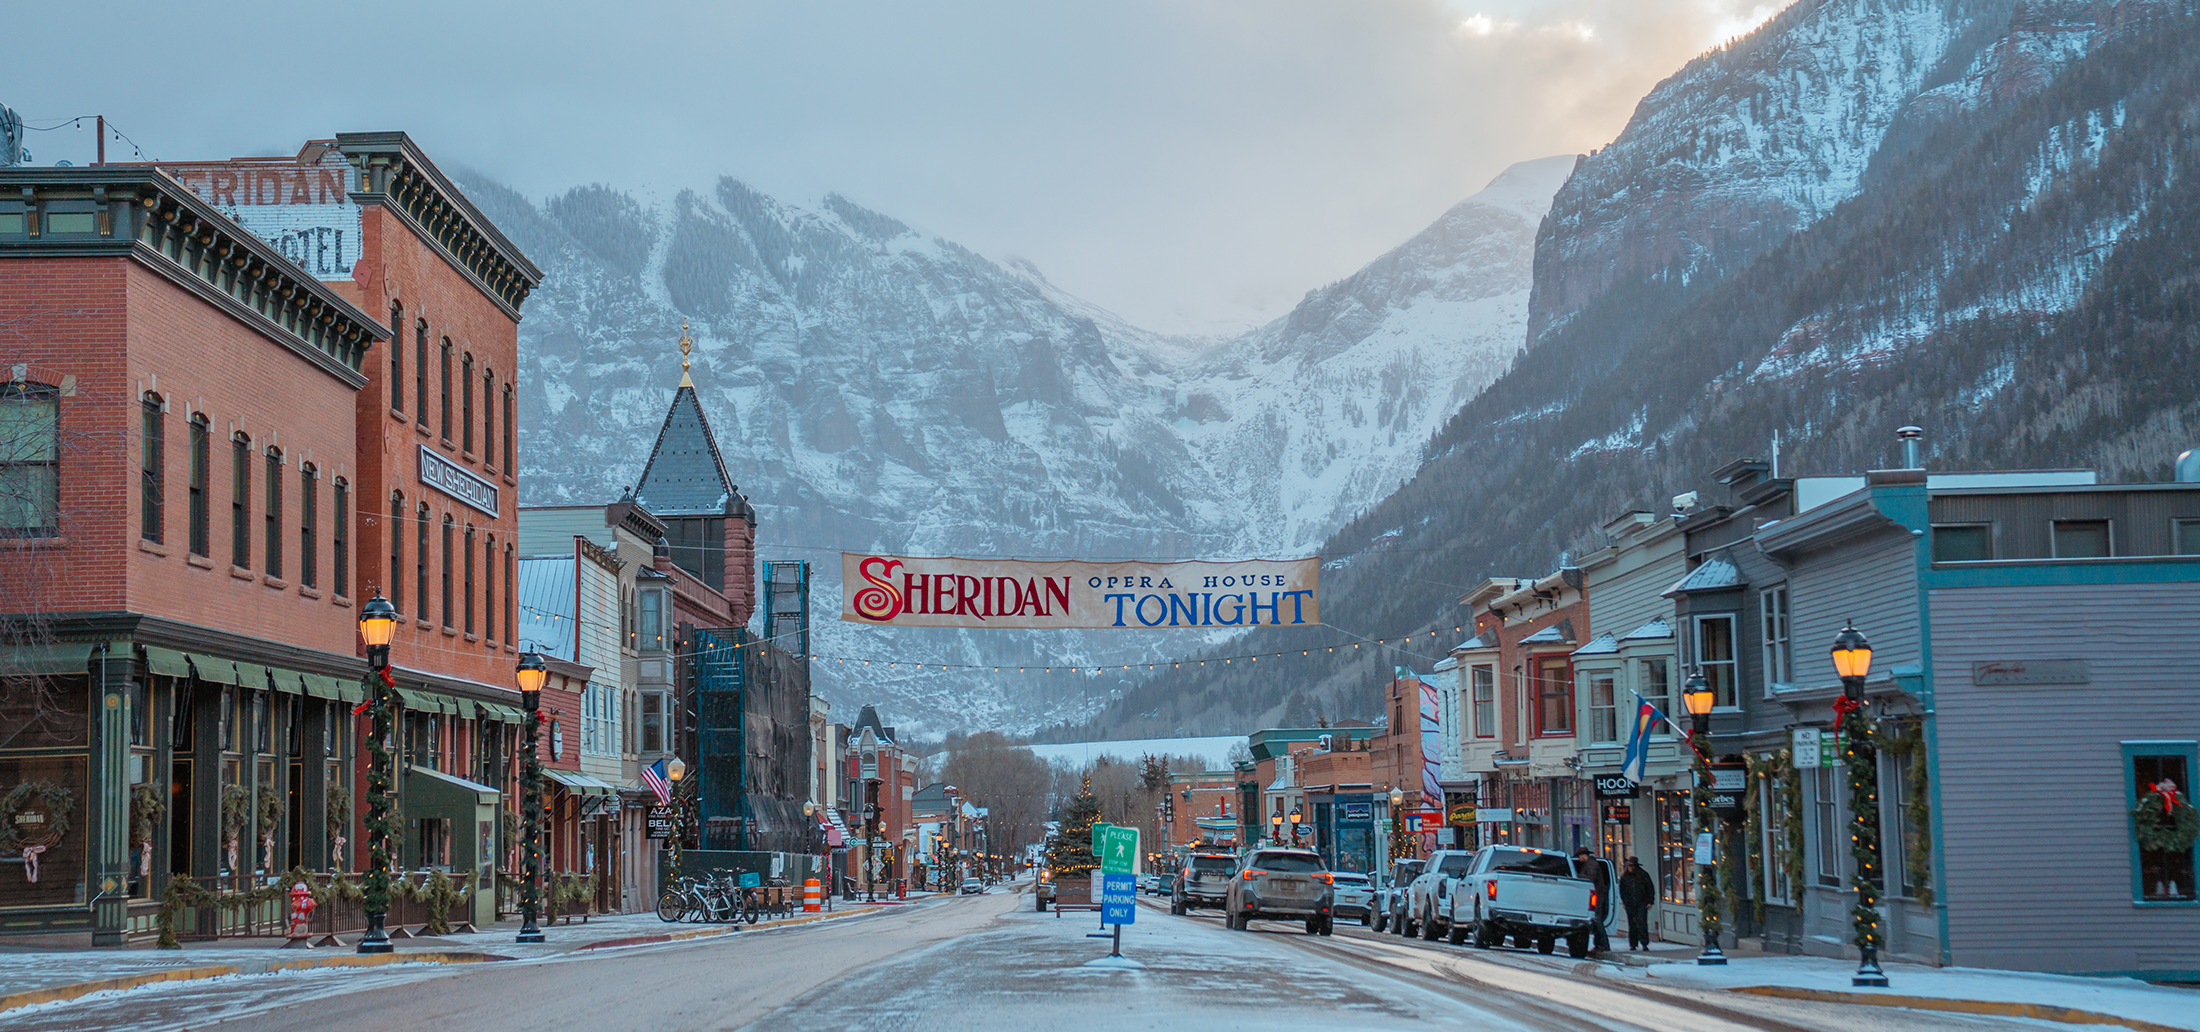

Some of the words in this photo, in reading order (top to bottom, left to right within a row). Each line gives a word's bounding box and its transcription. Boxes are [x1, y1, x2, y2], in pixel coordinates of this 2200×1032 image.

[268, 226, 351, 274] OTEL
[422, 455, 444, 484] NEW
[445, 466, 495, 511] SHERIDAN
[1088, 576, 1174, 588] OPERA
[1203, 575, 1286, 587] HOUSE
[853, 557, 1072, 621] SHERIDAN
[1104, 590, 1314, 626] TONIGHT
[1596, 778, 1635, 789] HOOK
[650, 807, 683, 815] AZAI
[1449, 810, 1476, 821] Parad
[1110, 831, 1133, 842] PLEASE
[1103, 865, 1130, 873] PEDESTRIANS
[1106, 881, 1132, 891] PERMIT
[1103, 894, 1134, 905] PARKING
[1109, 907, 1128, 917] ONLY
